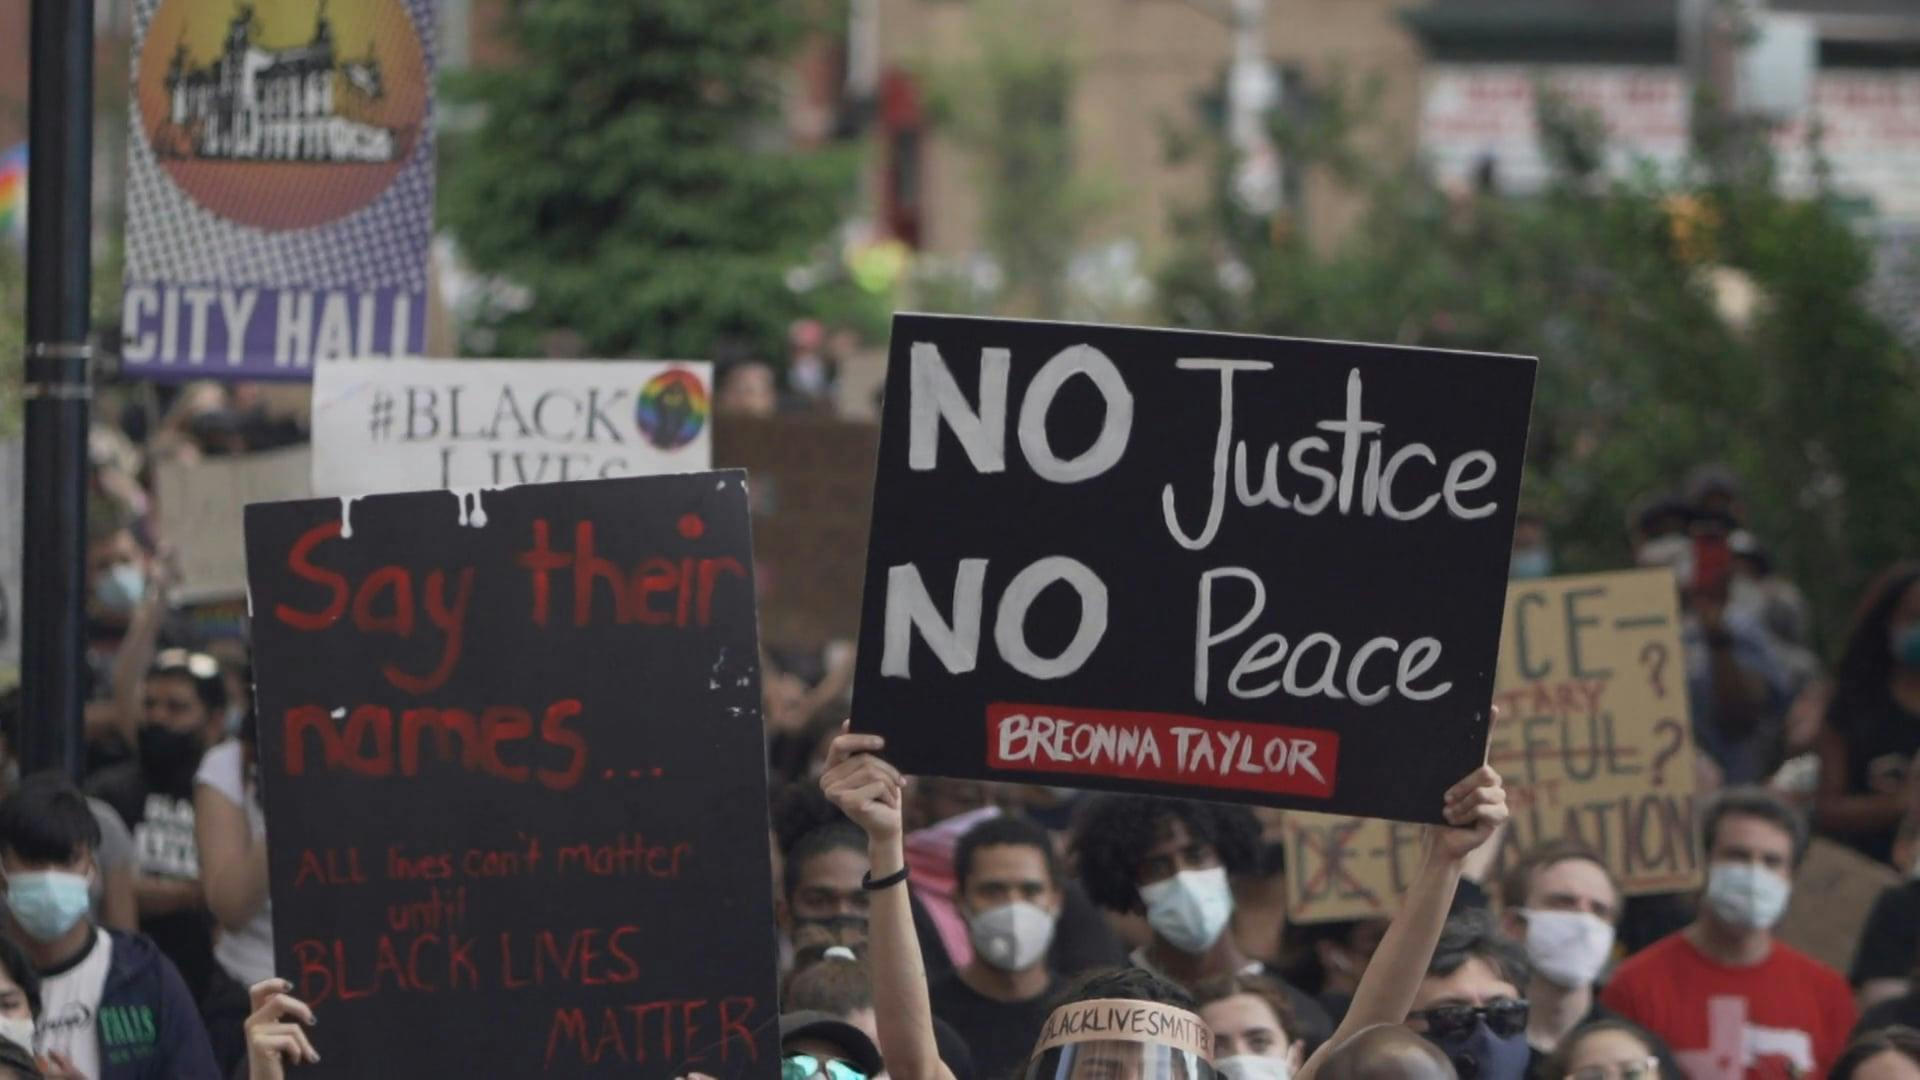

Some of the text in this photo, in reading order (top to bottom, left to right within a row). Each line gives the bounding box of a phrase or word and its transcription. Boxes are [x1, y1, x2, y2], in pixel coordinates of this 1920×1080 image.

[122, 286, 412, 366] CITY HALL
[370, 382, 629, 444] #BLACK
[909, 341, 1498, 549] NO Justice
[275, 513, 748, 693] Say their
[881, 556, 1453, 705] NO Peace
[998, 713, 1326, 785] BREONNA TAYLOR
[294, 830, 693, 889] ALL lives can't matter
[386, 884, 467, 932] until
[292, 925, 641, 1009] BLACK LIVES
[544, 996, 759, 1070] MATTER
